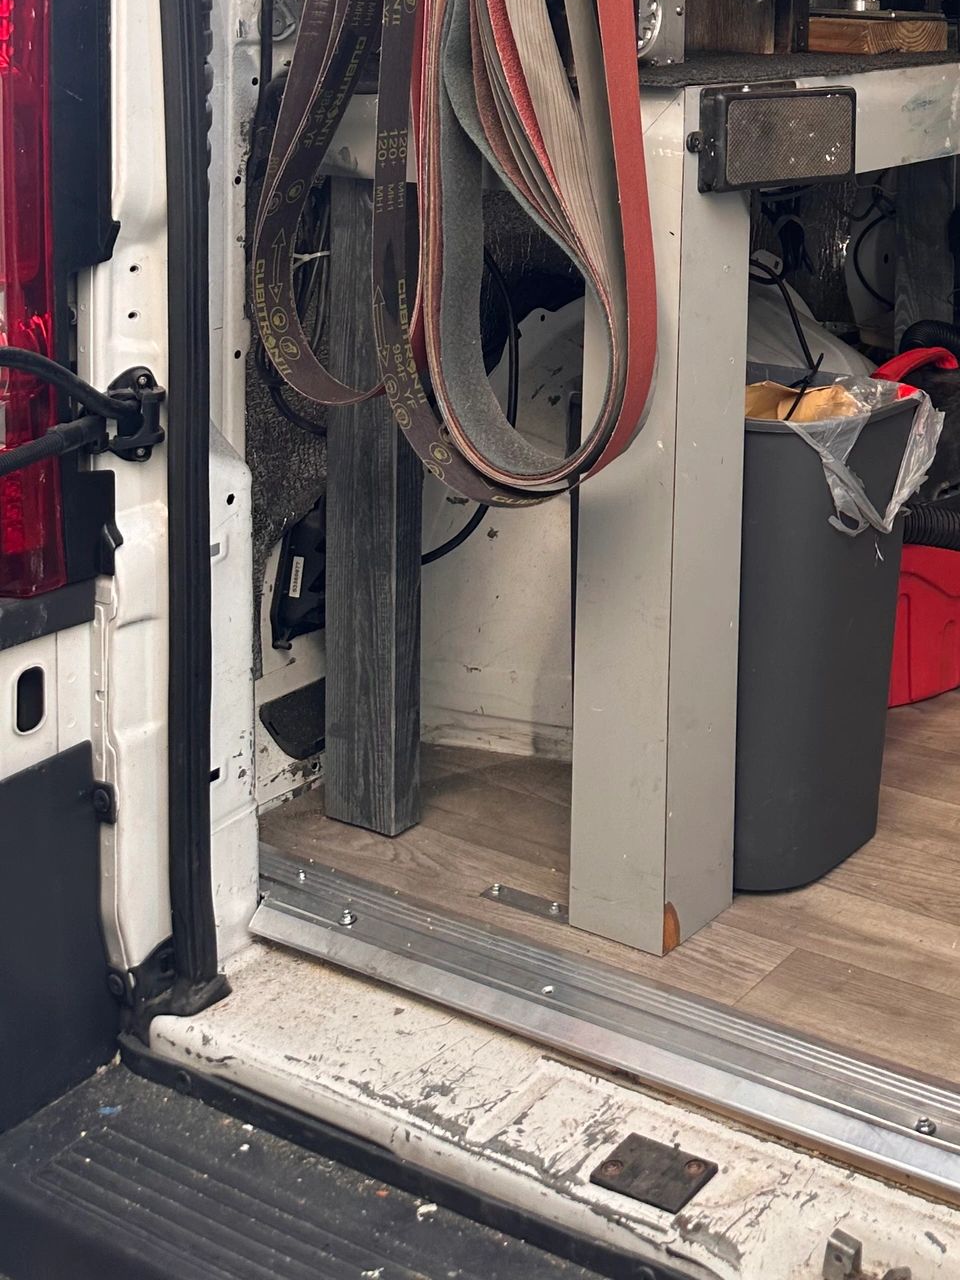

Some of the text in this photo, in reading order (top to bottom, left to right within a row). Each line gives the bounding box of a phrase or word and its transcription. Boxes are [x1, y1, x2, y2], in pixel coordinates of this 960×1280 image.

[376, 129, 388, 213] 120+ MH1
[389, 128, 398, 167] 120+
[392, 345, 418, 409] 984F YF
